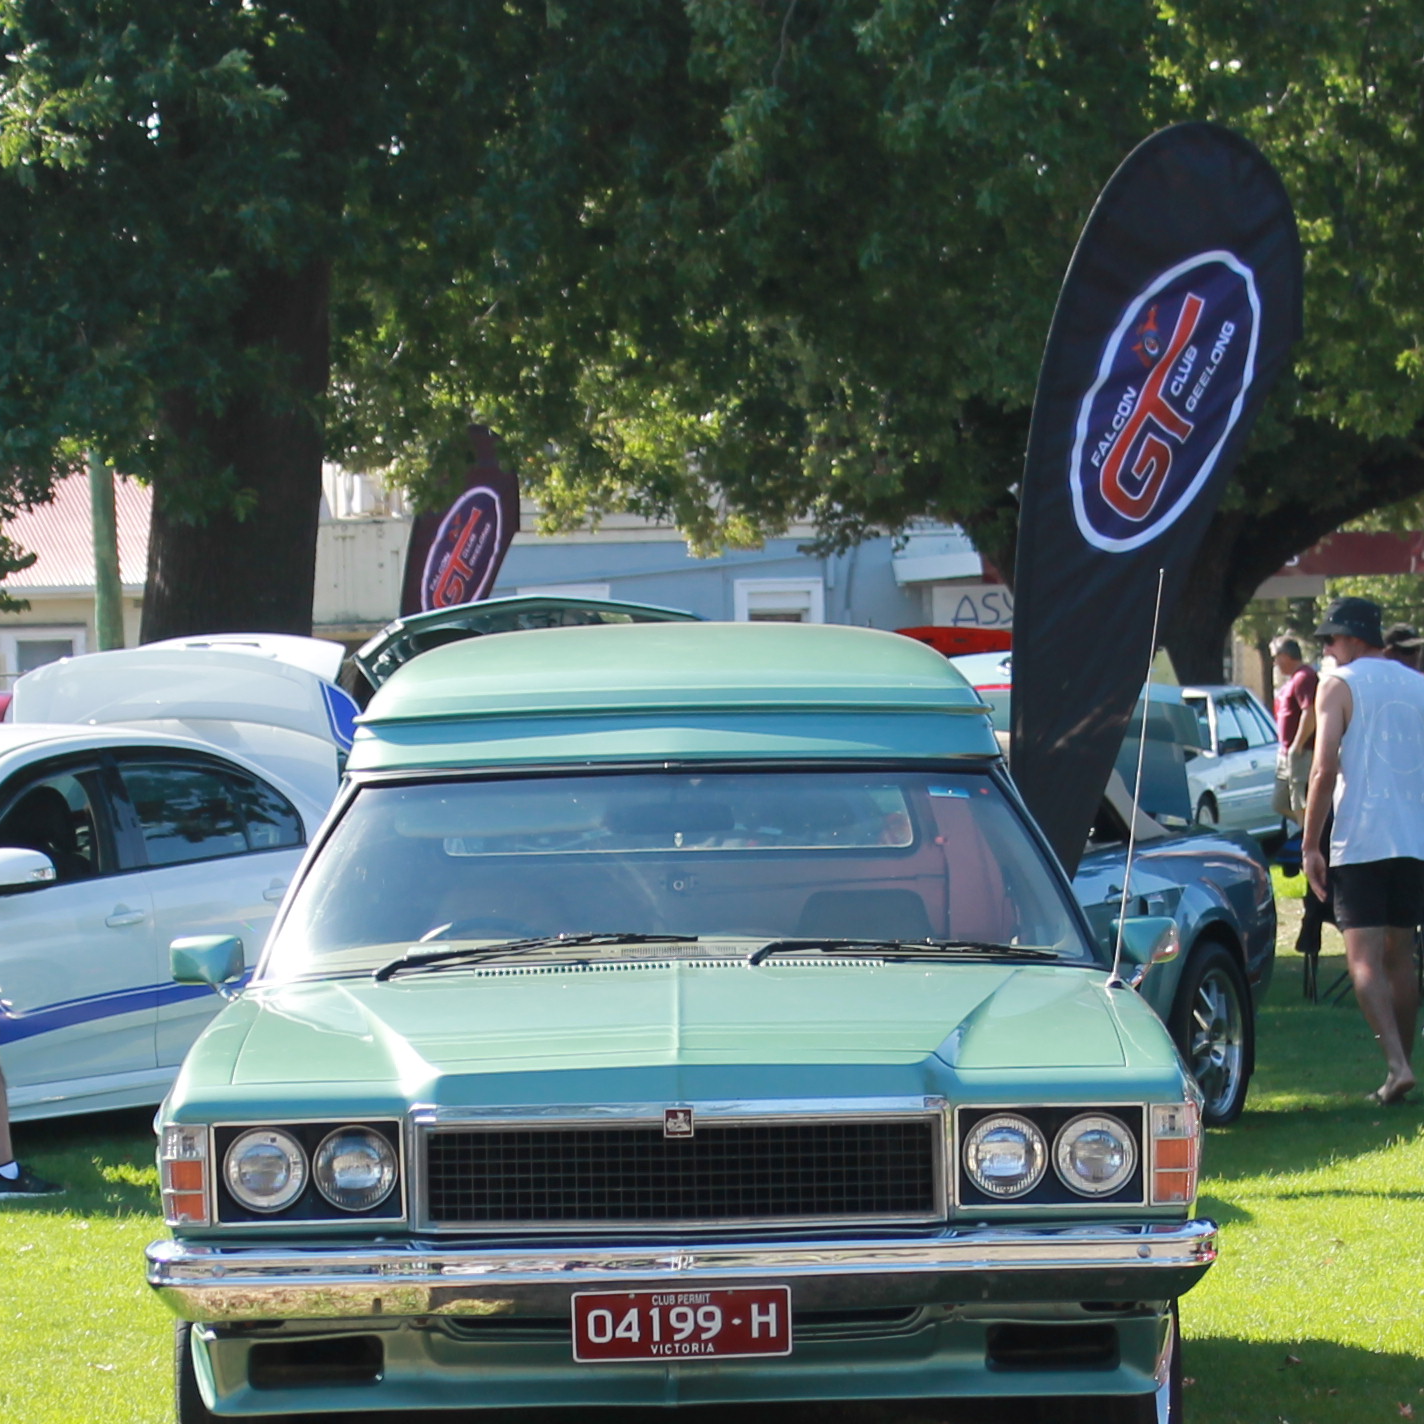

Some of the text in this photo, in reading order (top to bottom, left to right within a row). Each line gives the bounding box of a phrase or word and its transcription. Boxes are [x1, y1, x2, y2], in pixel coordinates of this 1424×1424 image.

[1170, 343, 1199, 397] CLUB
[1184, 319, 1236, 413] GEELONG
[1090, 385, 1138, 468] FALCON
[1099, 292, 1206, 522] GT
[429, 551, 452, 592] FALCON
[433, 506, 483, 609] GT
[460, 532, 477, 559] CLUB
[651, 1292, 711, 1306] CLUB PERMIT
[650, 1342, 715, 1355] VICTORIA
